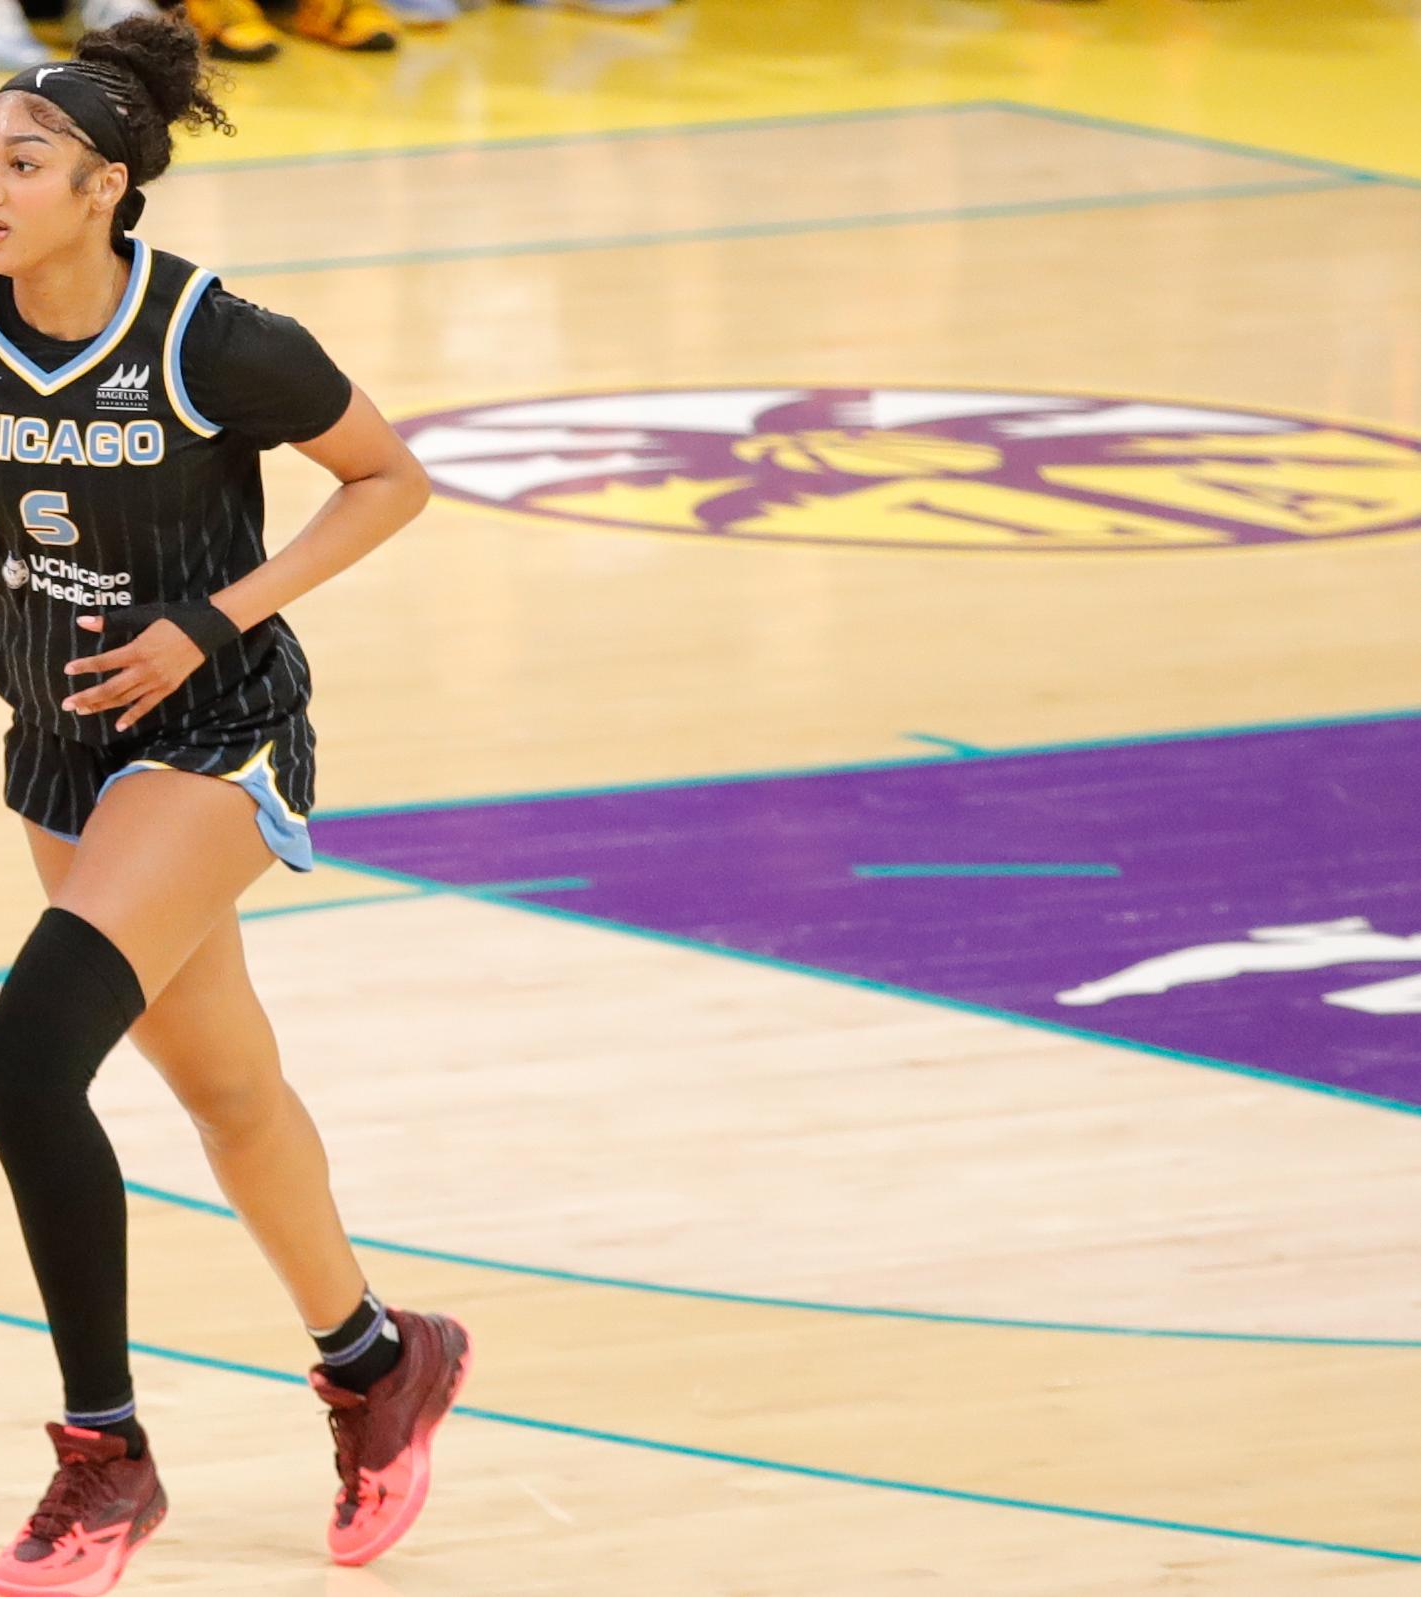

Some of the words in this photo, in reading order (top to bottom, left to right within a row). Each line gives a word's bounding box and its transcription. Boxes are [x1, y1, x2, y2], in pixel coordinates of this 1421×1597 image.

[96, 391, 149, 401] MAGELLAN
[19, 490, 80, 546] 5
[30, 553, 131, 590] UChicago
[30, 571, 131, 607] Medicine
